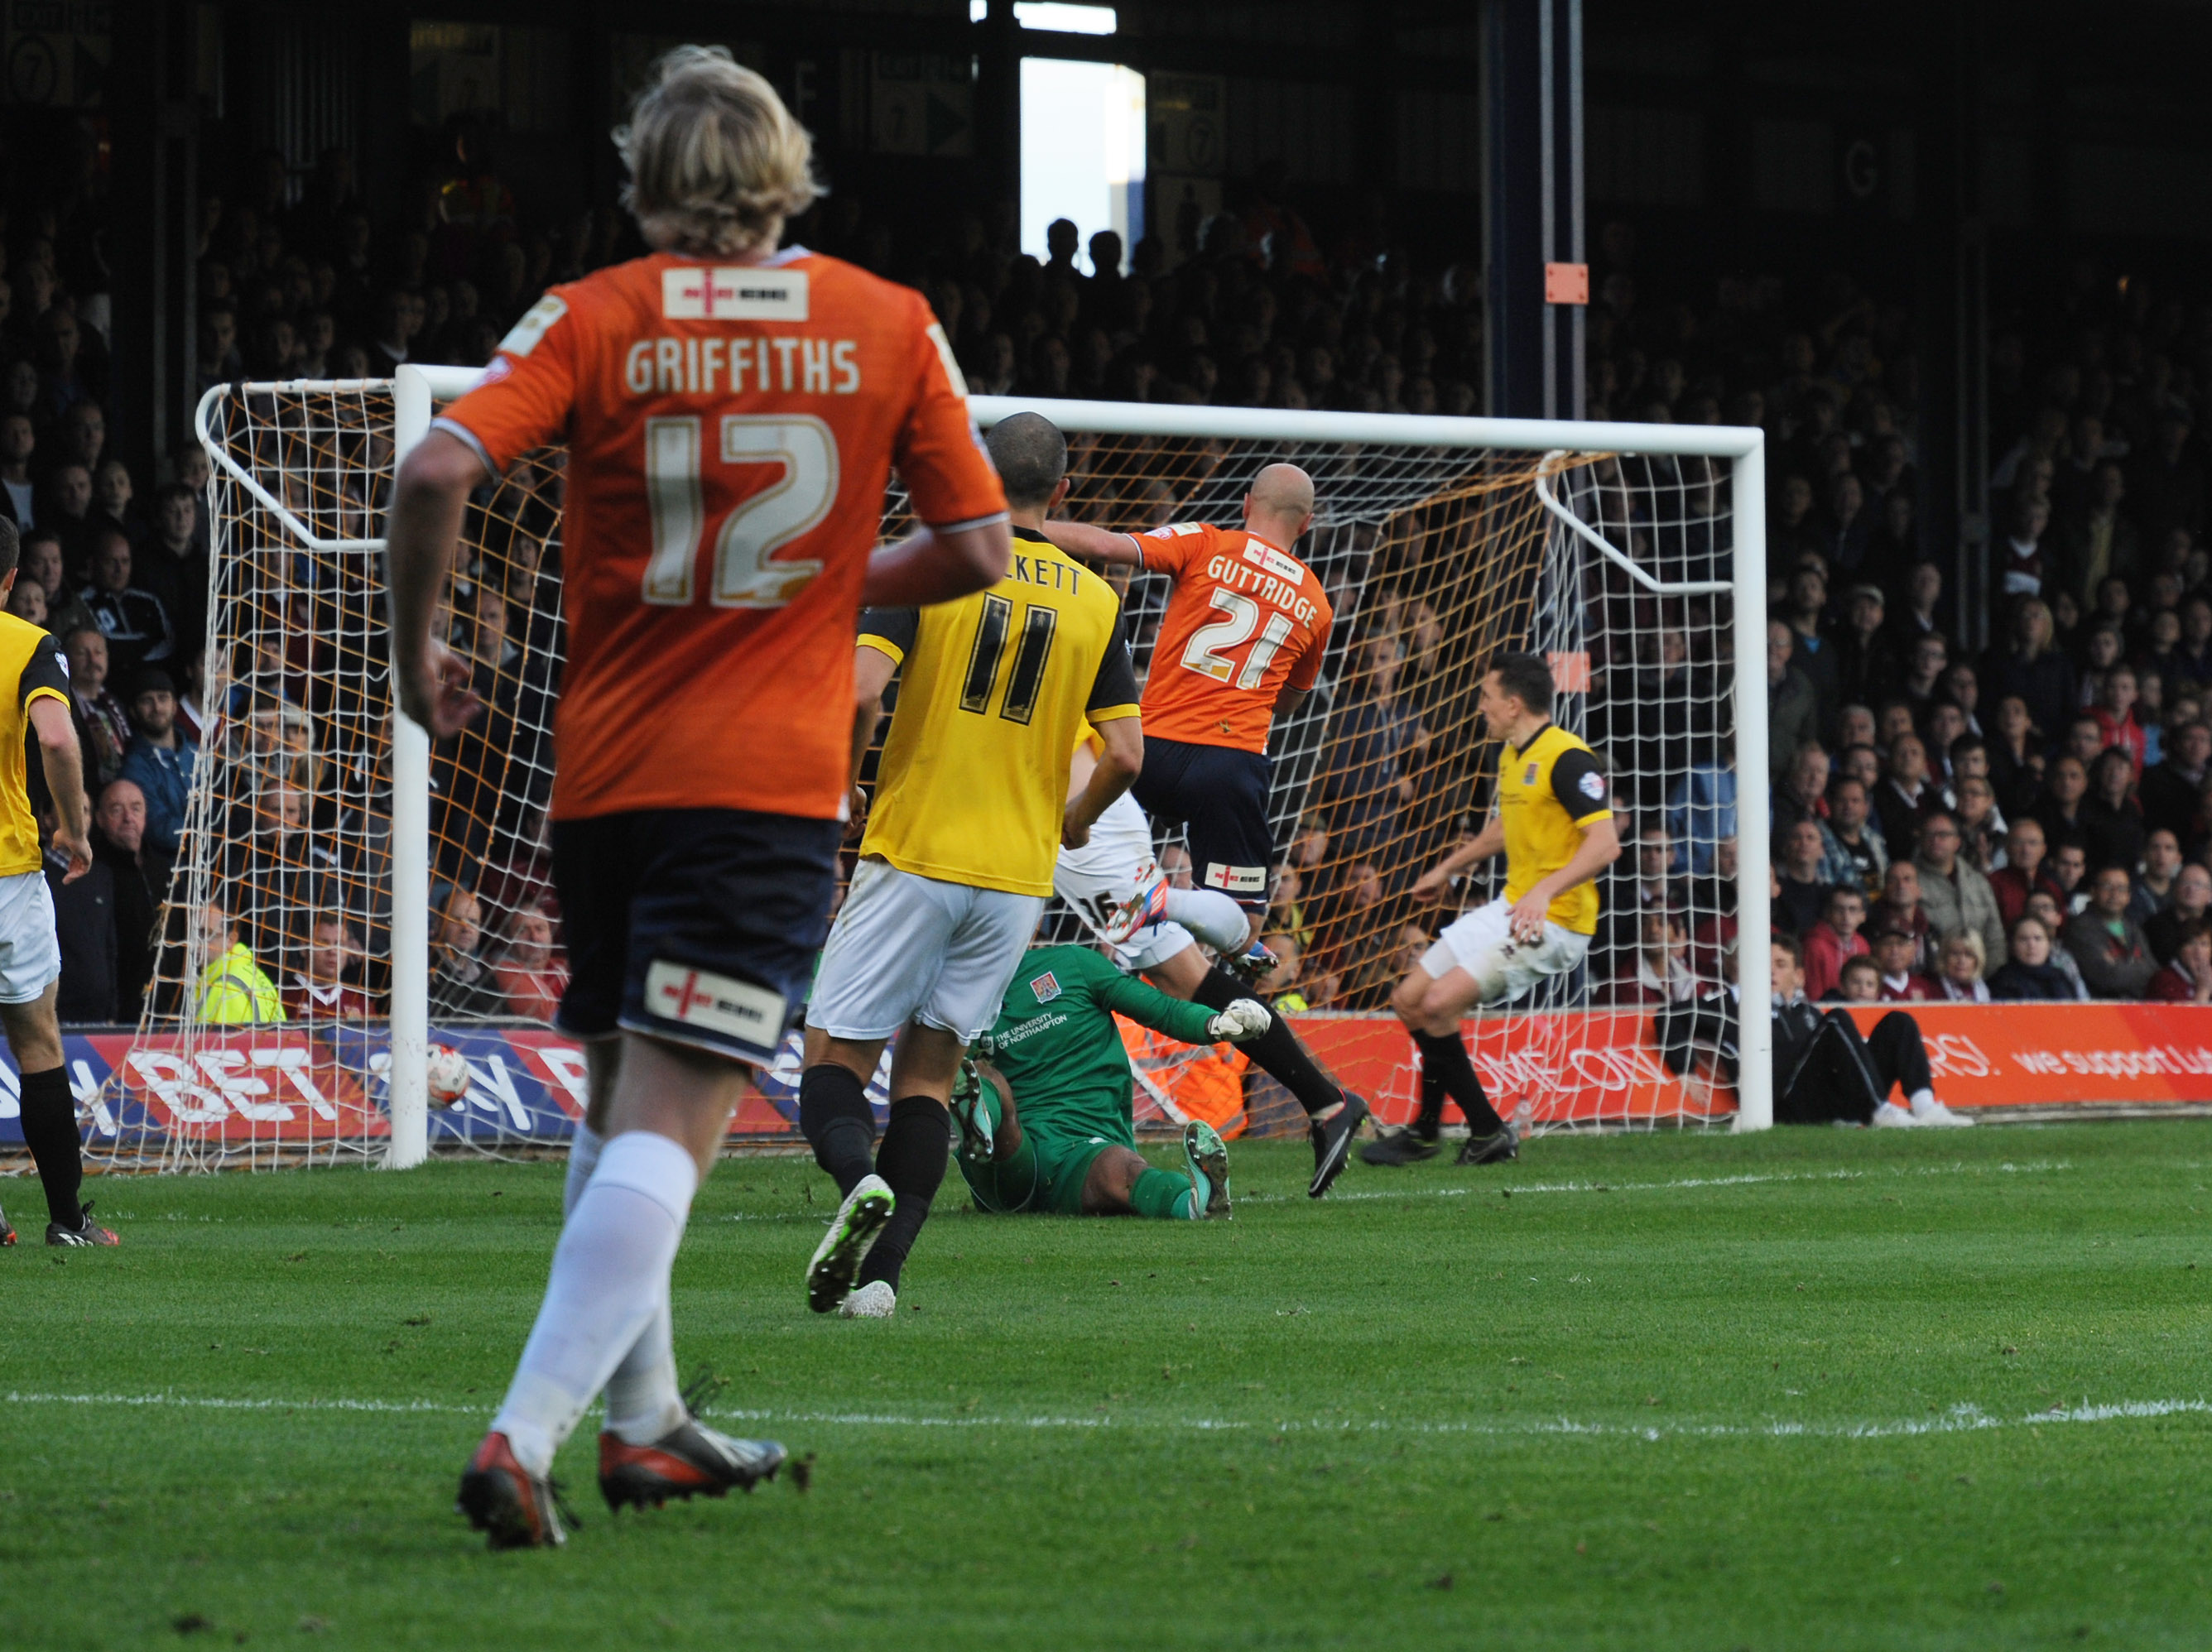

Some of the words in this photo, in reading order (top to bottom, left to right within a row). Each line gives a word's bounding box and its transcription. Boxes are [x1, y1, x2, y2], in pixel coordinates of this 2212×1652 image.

[626, 336, 861, 395] GRIFFITHS
[641, 413, 840, 609] 12
[1004, 553, 1081, 596] KETT
[1207, 555, 1318, 629] GUTTRIDGE
[959, 590, 1058, 727] 11
[1180, 586, 1294, 690] 21
[996, 1030, 1011, 1043] THE
[1011, 1012, 1053, 1035] UNIVERSITY
[998, 1039, 1010, 1050] OF
[1009, 1014, 1068, 1045] NORTHAMPTON
[127, 1047, 338, 1123] BET
[1570, 1047, 1671, 1091] ON
[2011, 1050, 2068, 1075] we
[2060, 1045, 2182, 1080] support
